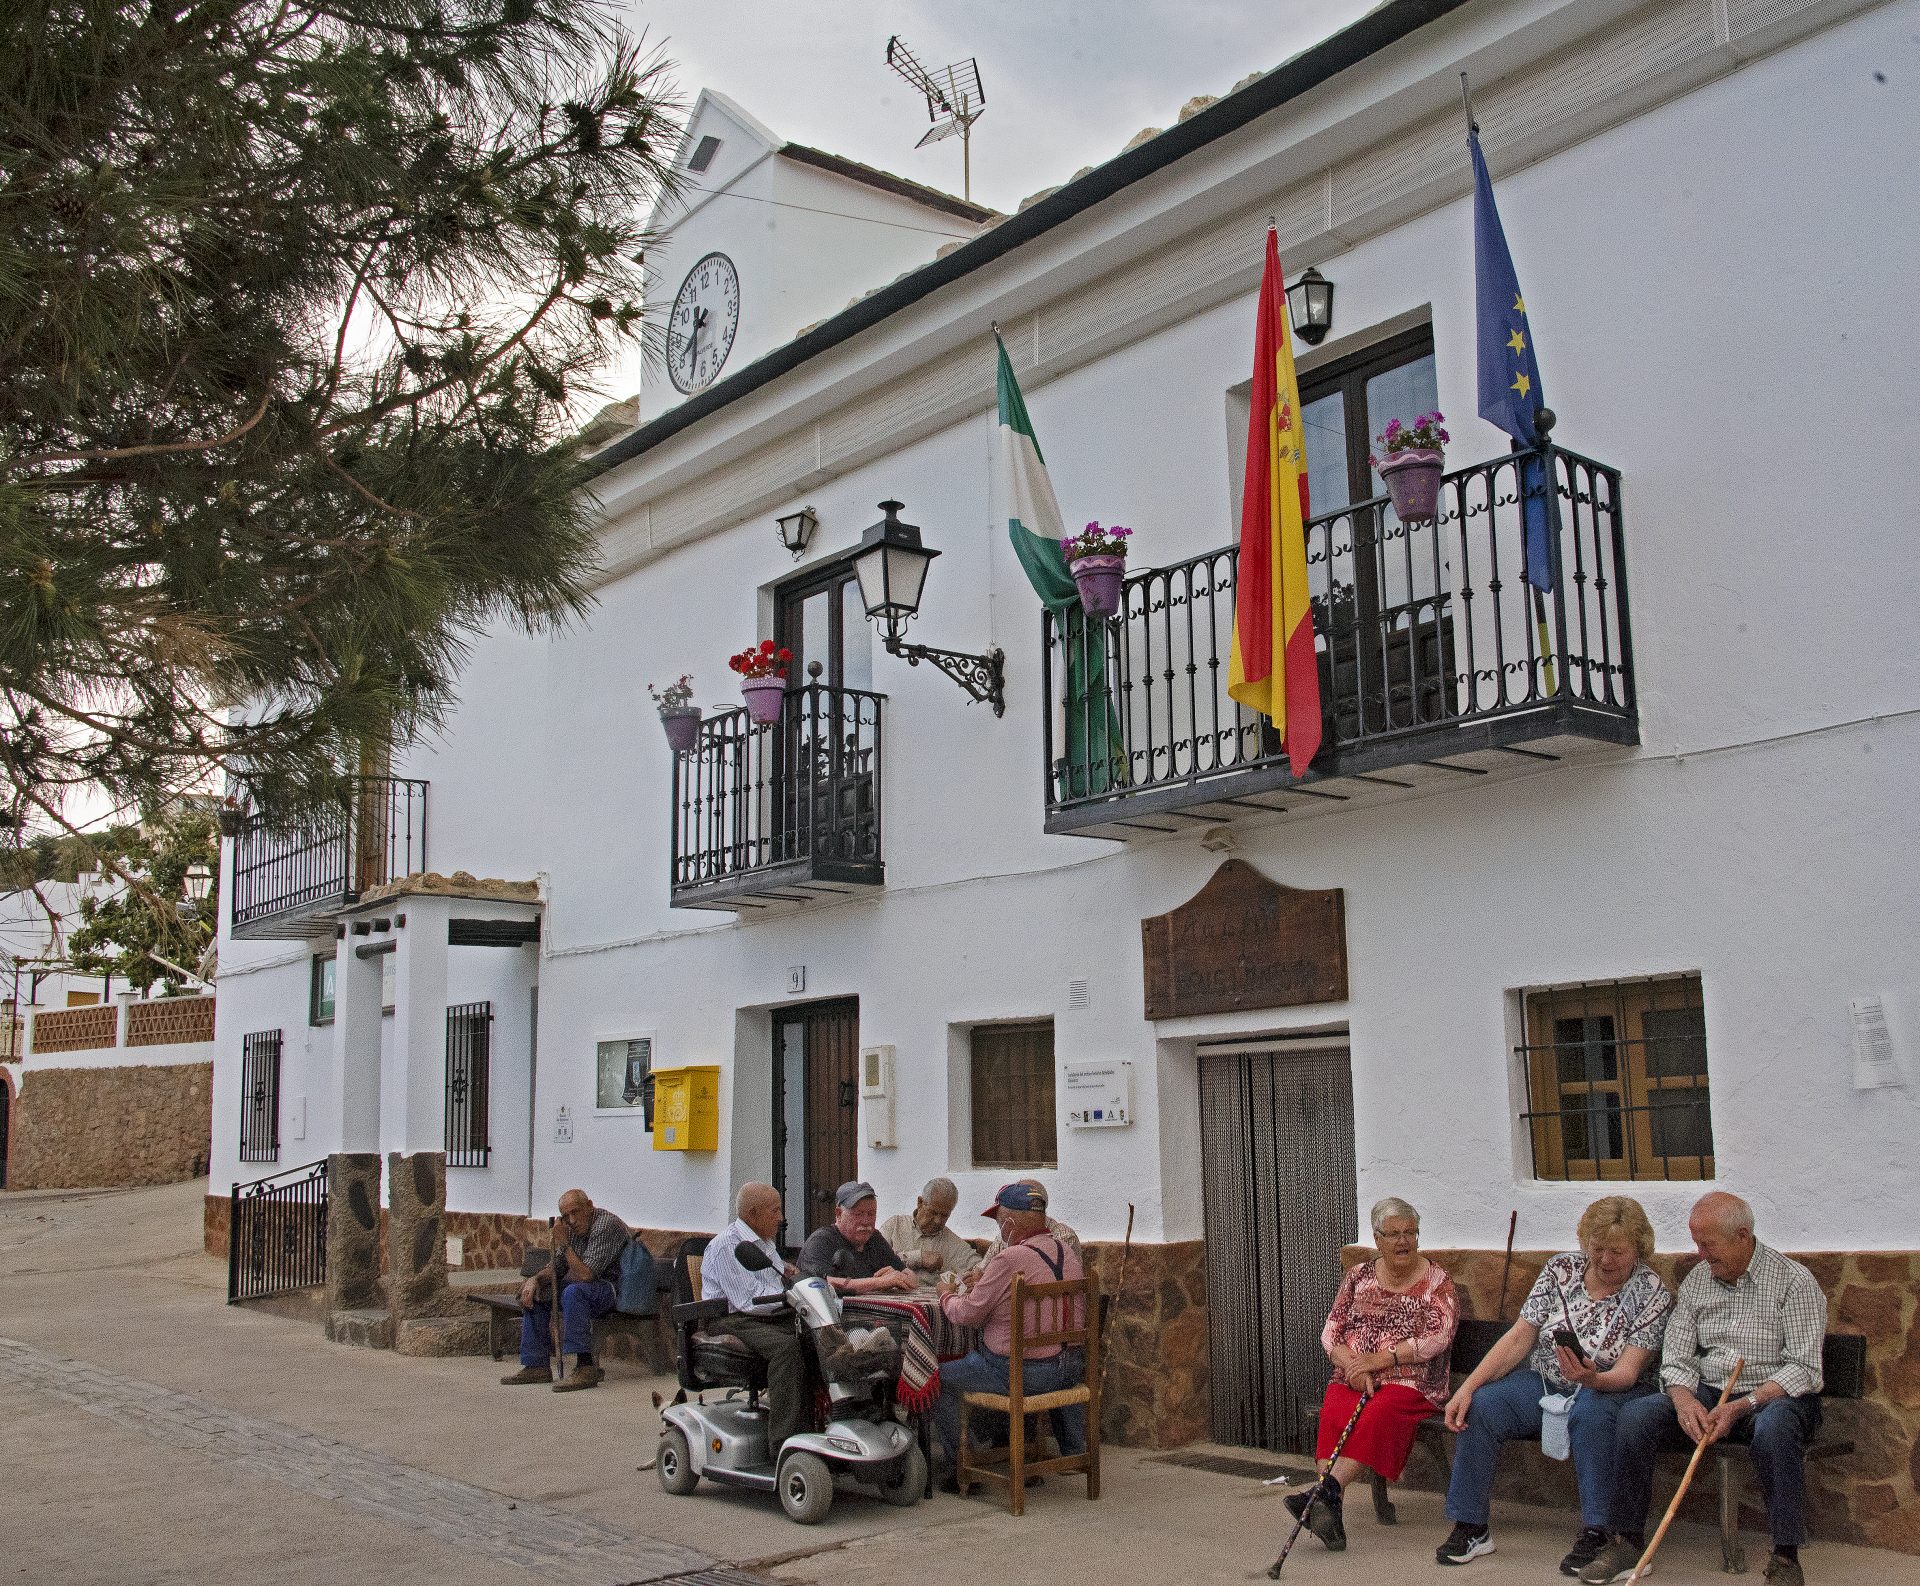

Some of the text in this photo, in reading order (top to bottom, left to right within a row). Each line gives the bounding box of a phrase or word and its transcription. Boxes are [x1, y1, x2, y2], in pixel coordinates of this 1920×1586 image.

[700, 271, 710, 291] 12
[715, 268, 719, 286] 1
[689, 286, 697, 304] 11
[723, 278, 729, 296] 2
[680, 307, 690, 326] 10
[728, 300, 733, 317] 3
[723, 326, 728, 342] 4
[680, 353, 686, 370] 8
[712, 348, 718, 366] 5
[700, 361, 706, 378] 6
[792, 972, 799, 989] 9
